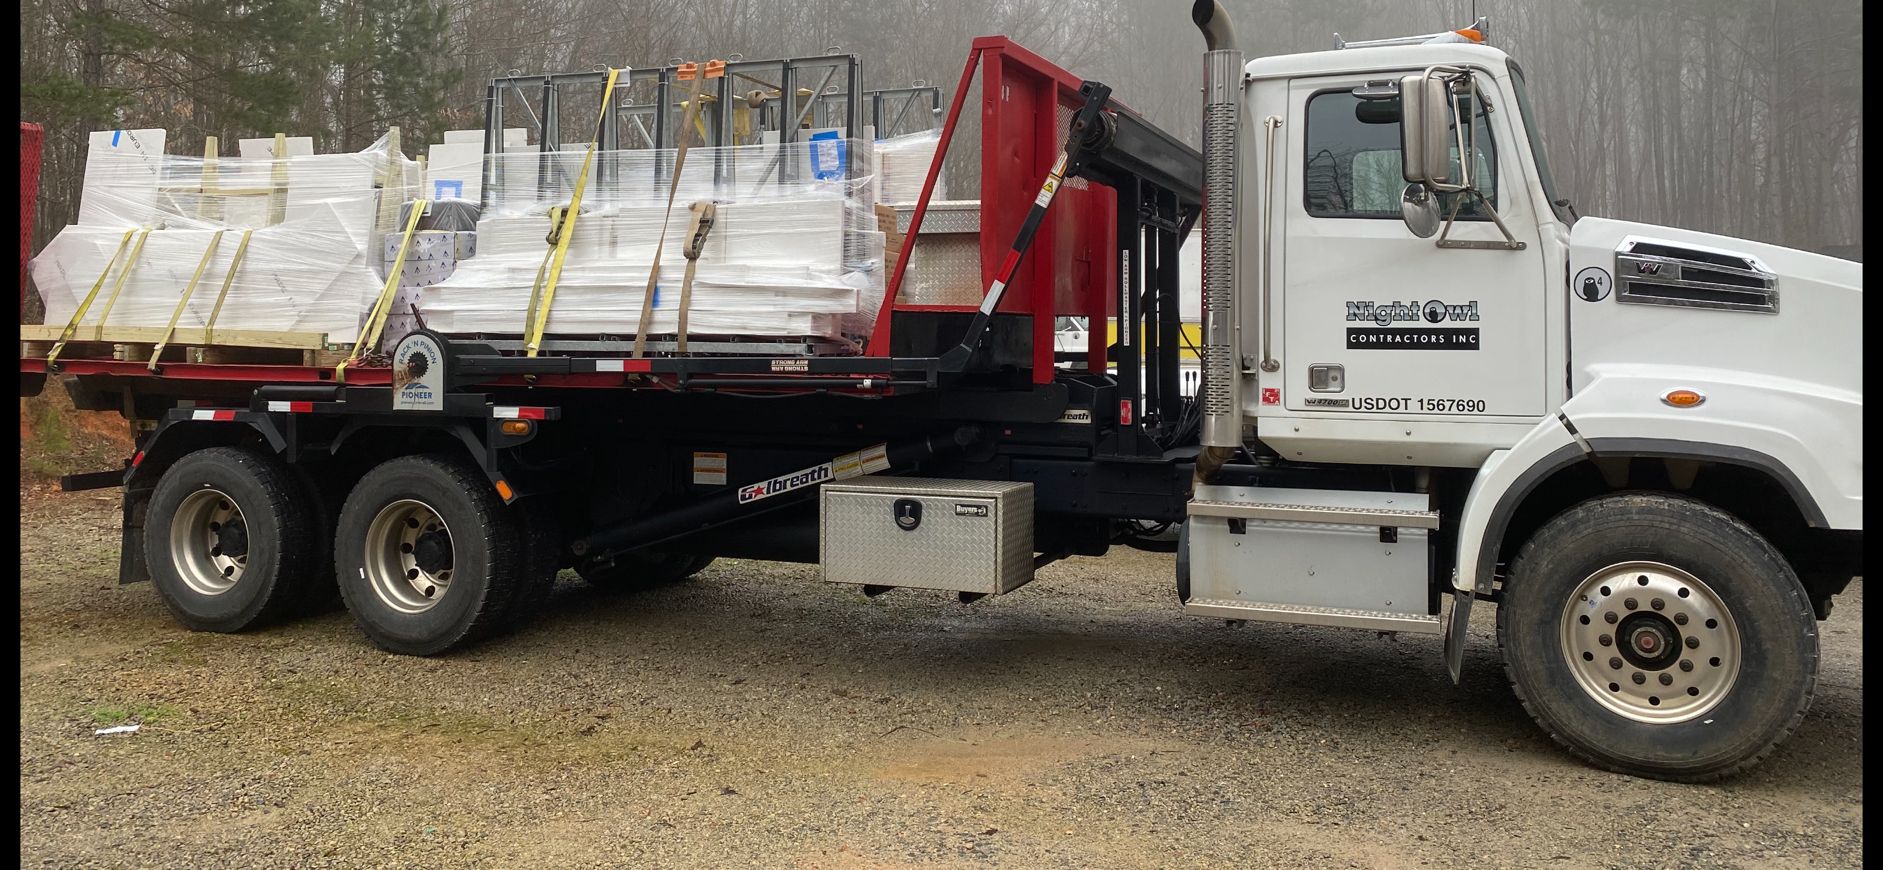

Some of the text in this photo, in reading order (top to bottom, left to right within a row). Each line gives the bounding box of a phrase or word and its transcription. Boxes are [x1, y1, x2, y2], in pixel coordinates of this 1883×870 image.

[1597, 277, 1603, 286] 4
[1345, 299, 1480, 326] Night Owl
[1350, 334, 1477, 343] CONTRACTORS INC
[398, 343, 412, 365] RACK
[419, 340, 437, 365] PINION
[401, 391, 433, 399] PIONEER
[1351, 398, 1412, 411] USDOT
[1417, 398, 1486, 412] 1567690
